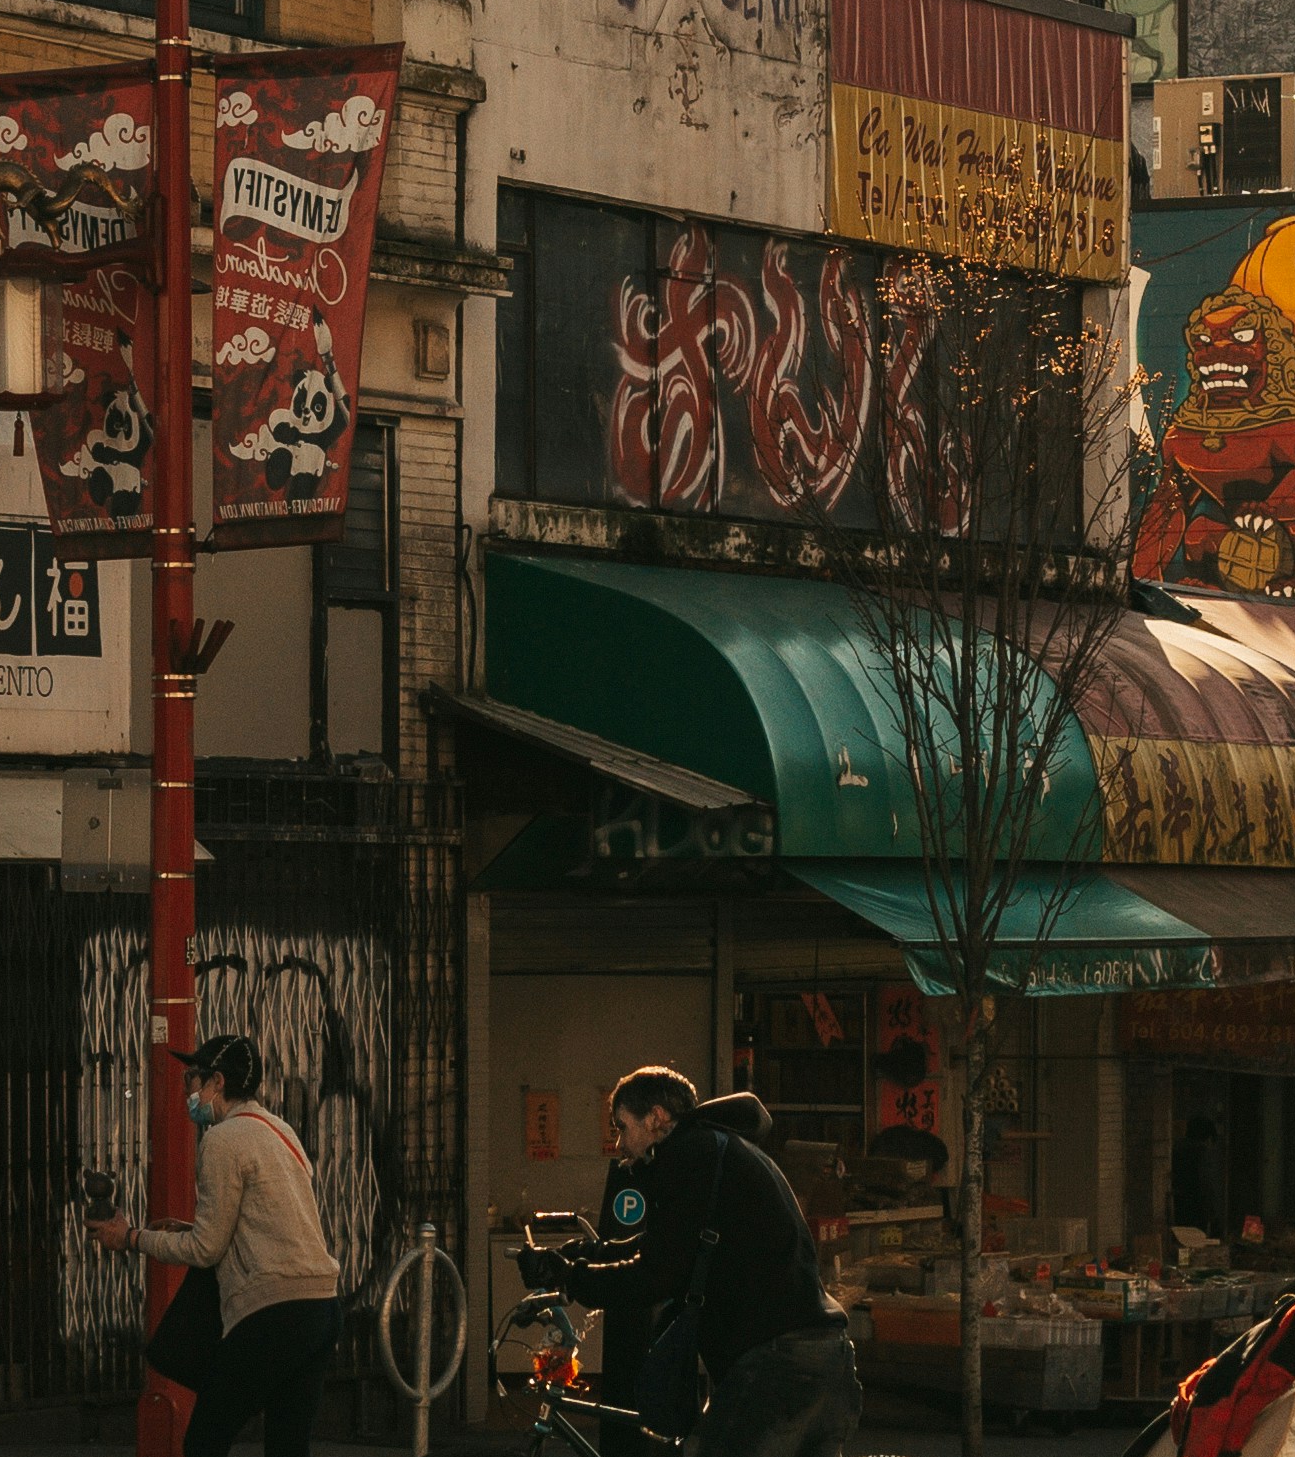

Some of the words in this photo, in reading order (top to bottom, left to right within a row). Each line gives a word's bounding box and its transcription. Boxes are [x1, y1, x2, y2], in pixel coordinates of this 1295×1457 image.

[858, 106, 892, 159] Ca
[903, 115, 949, 169] Wah
[622, 1194, 639, 1219] P
